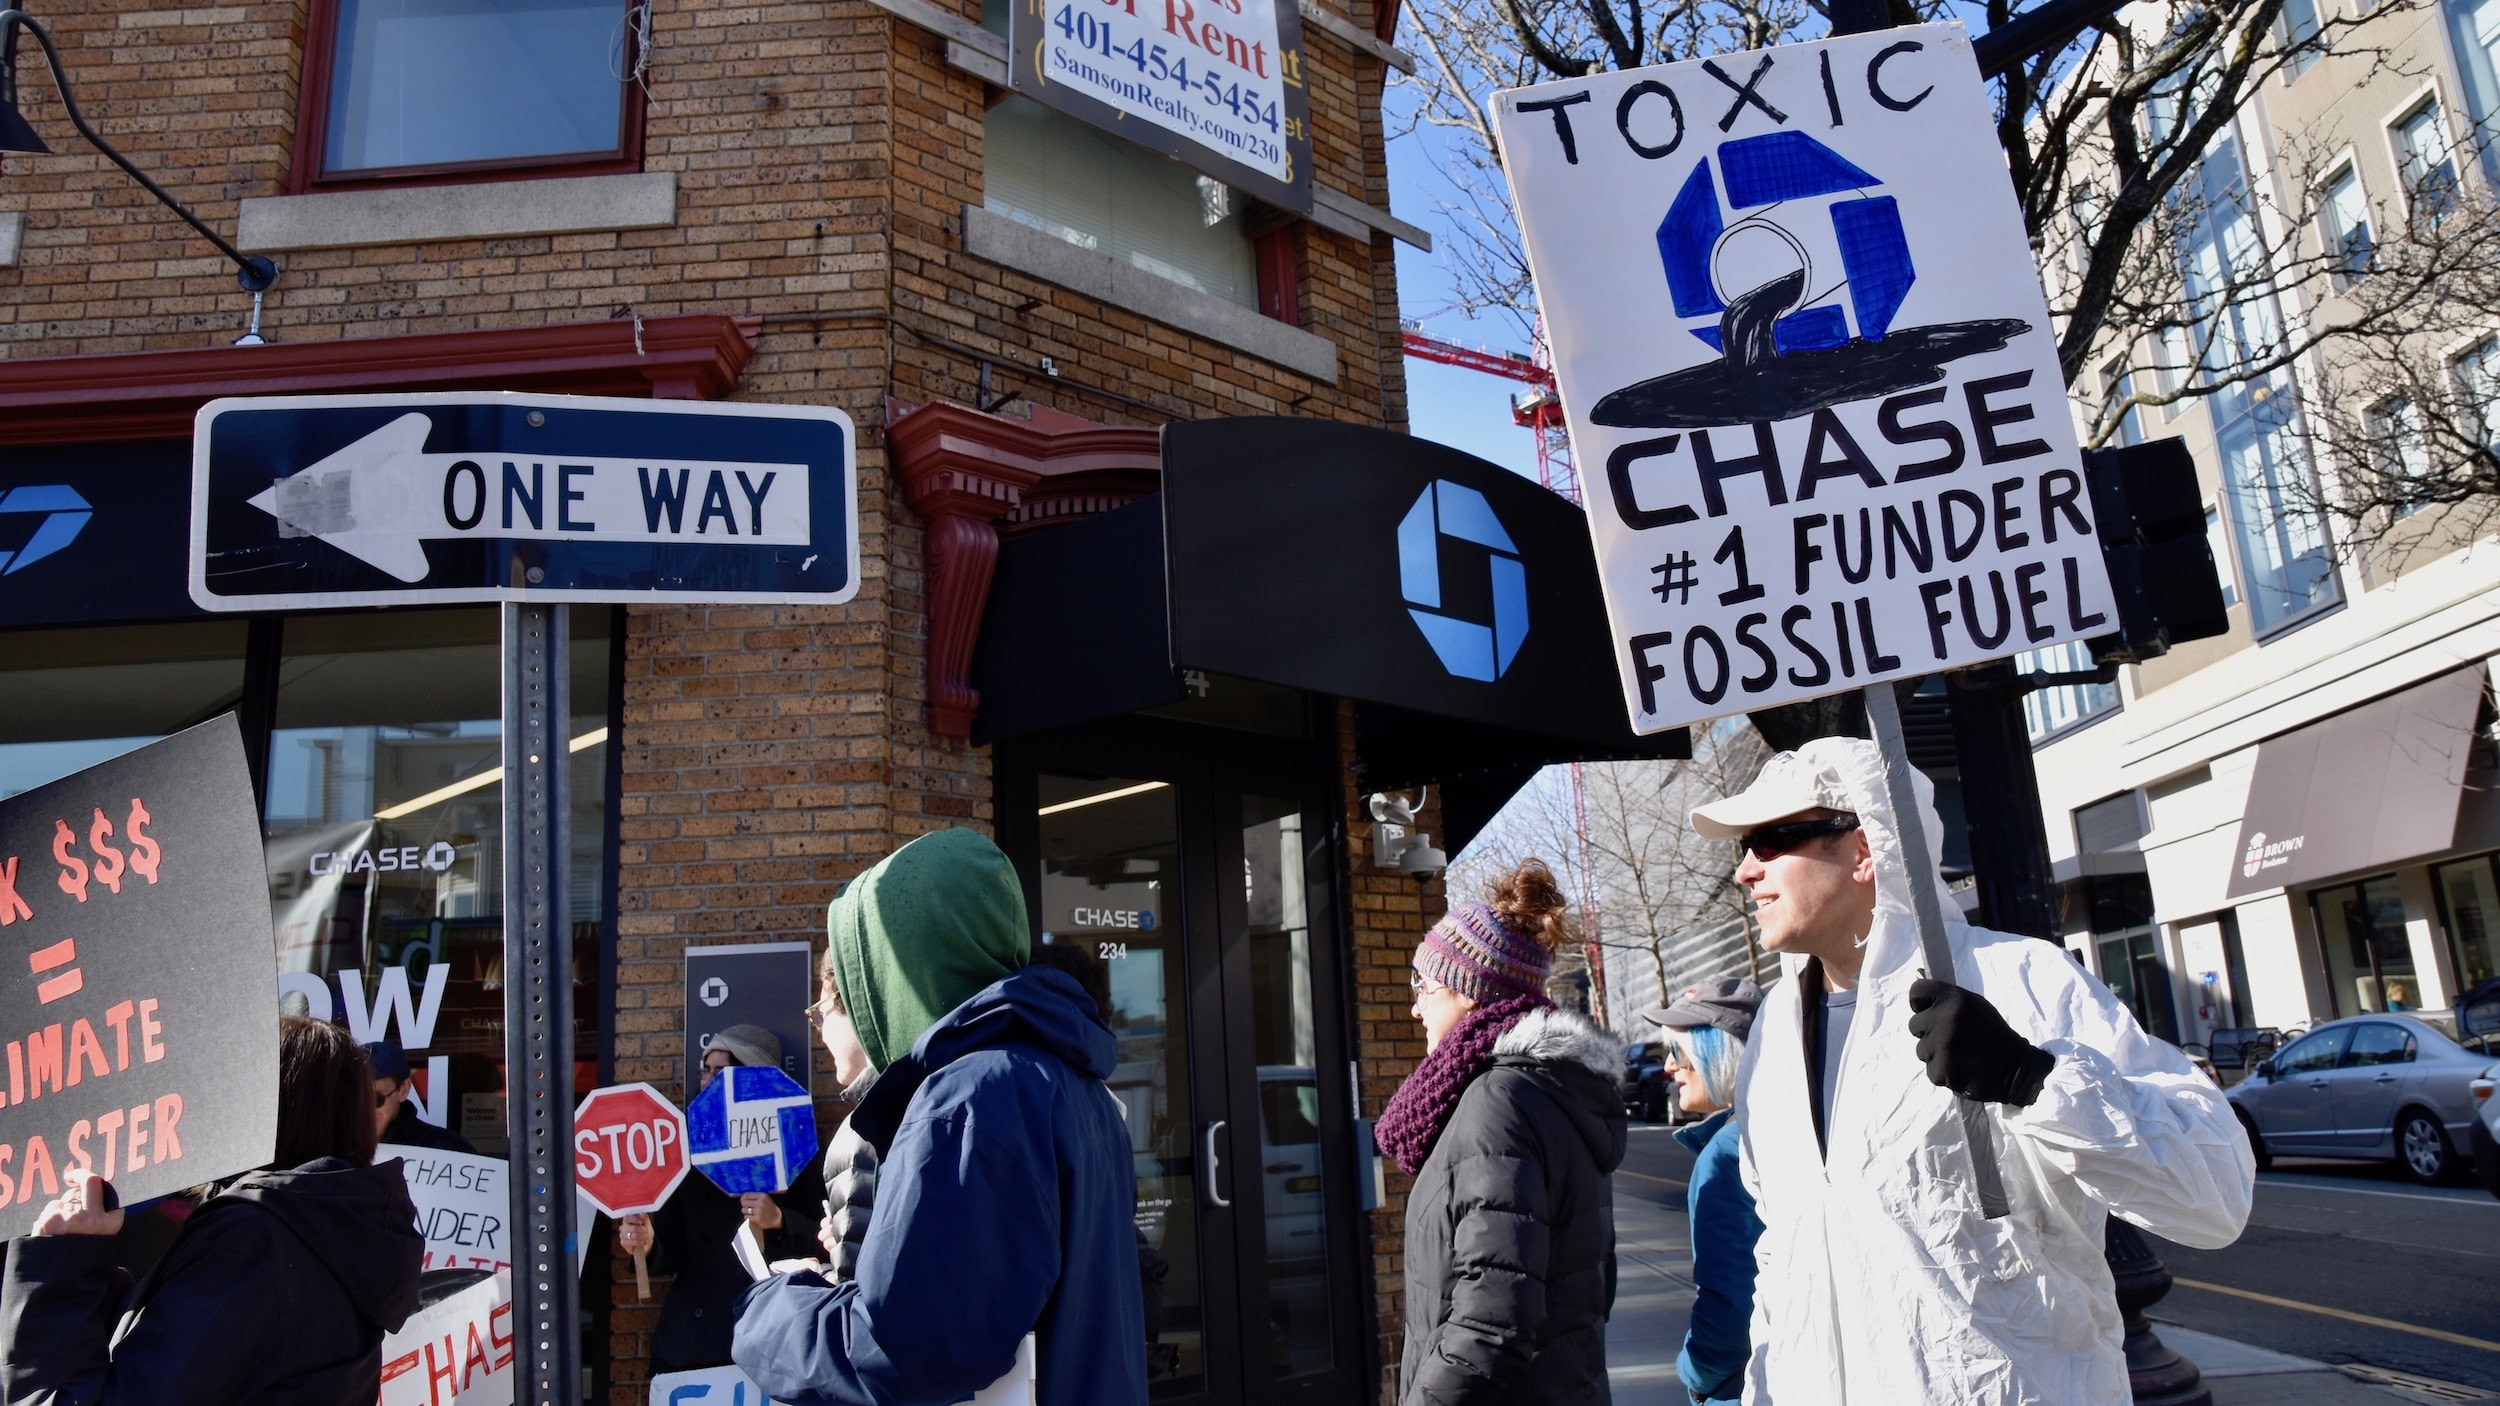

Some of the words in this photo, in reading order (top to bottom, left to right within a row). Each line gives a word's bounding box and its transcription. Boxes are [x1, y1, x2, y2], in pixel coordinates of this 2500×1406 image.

[1053, 3, 1280, 134] 401-454-5454
[1516, 40, 1935, 165] TOXIC
[1053, 46, 1280, 165] SamsonRealty.com/230
[1606, 369, 2054, 531] CHASE
[443, 460, 596, 532] ONE
[637, 467, 778, 536] WAY
[1651, 525, 1765, 607] #1
[1793, 468, 2092, 596] FUNDER
[1629, 597, 1901, 715] FOSSIL
[1918, 557, 2106, 661] FUEL
[309, 846, 421, 876] CHASE
[2263, 835, 2305, 859] BROWN
[1074, 907, 1139, 929] CHASE
[1099, 942, 1127, 960] 234
[575, 1118, 677, 1179] STOP
[729, 1116, 779, 1150] CHASE
[414, 1206, 501, 1250] NDER
